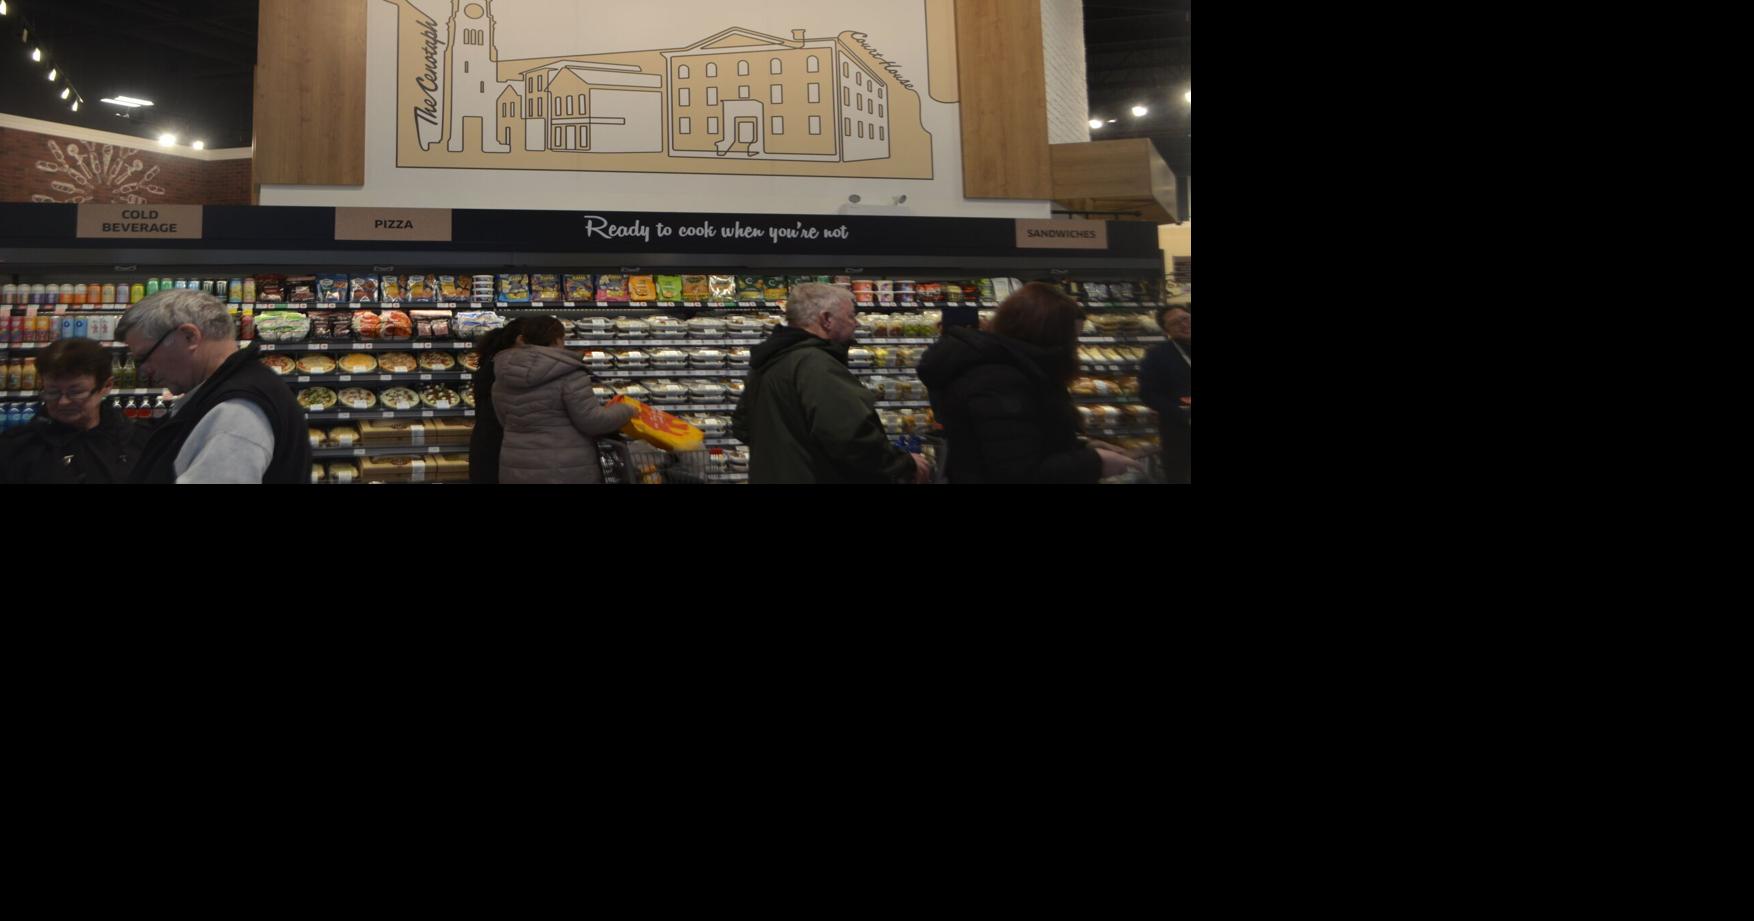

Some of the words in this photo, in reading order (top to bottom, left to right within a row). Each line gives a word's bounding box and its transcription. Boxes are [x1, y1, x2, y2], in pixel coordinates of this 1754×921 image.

[416, 20, 445, 93] Cenotaph
[851, 31, 883, 60] Court
[879, 61, 914, 91] House
[414, 98, 438, 125] The
[121, 209, 159, 220] COLD
[375, 219, 414, 229] PIZZA
[102, 223, 178, 233] BEVERAGE
[584, 215, 650, 242] Ready
[656, 222, 672, 237] to
[678, 220, 717, 238] cook
[721, 221, 765, 239] when
[769, 221, 819, 244] you're
[823, 224, 849, 240] not
[1027, 229, 1096, 239] SANDWICHES
